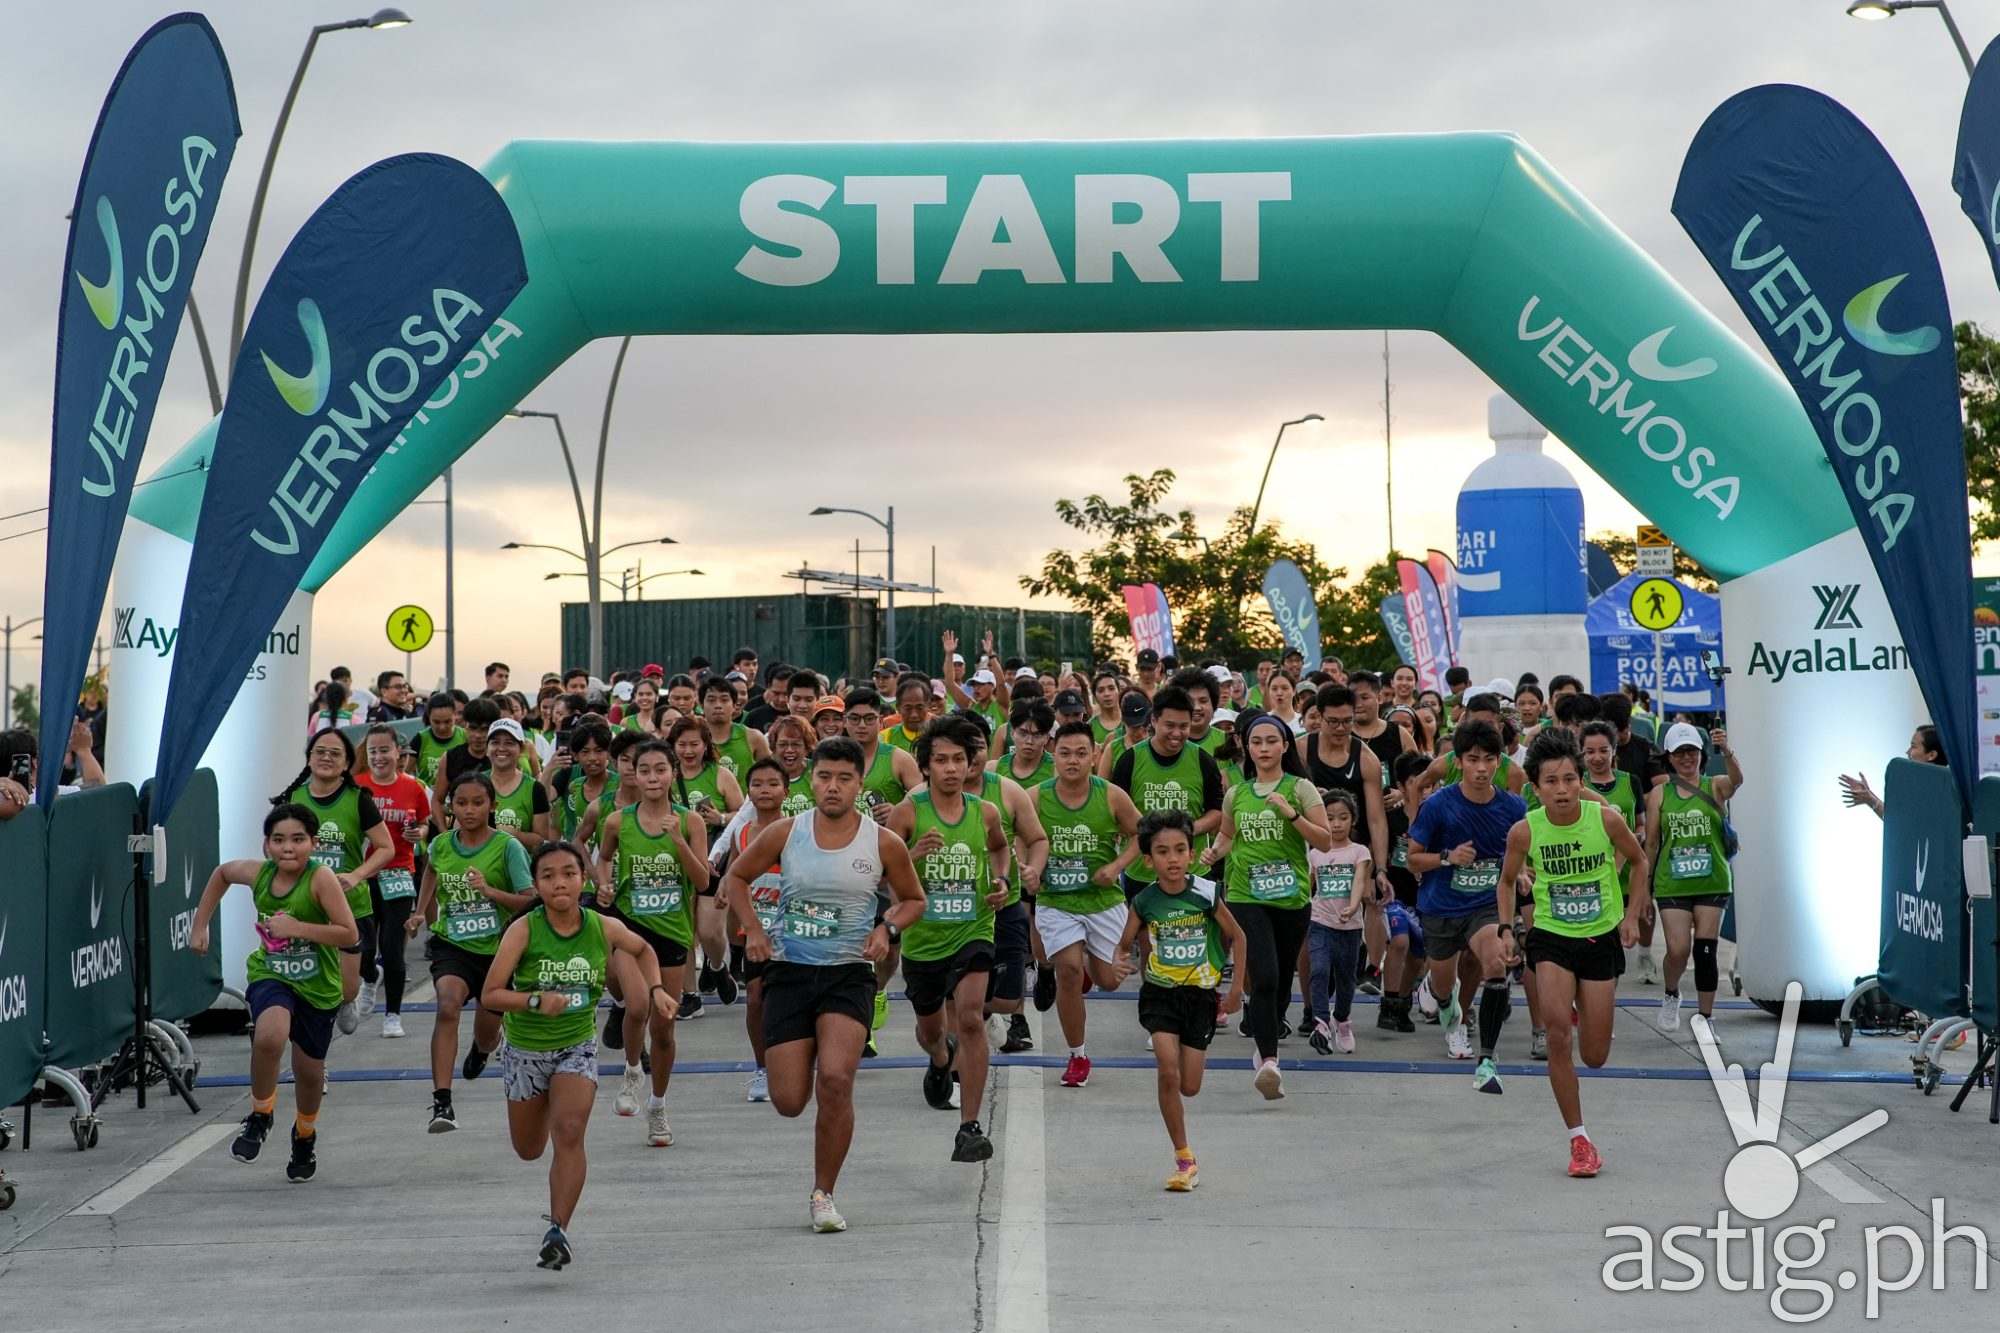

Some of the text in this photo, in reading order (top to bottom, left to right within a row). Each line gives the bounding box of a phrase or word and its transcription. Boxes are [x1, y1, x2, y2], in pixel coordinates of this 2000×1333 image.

[733, 171, 1292, 287] START
[82, 135, 217, 498] VERMOSA
[1731, 213, 1916, 552] VERMOSA
[1517, 295, 1740, 521] VERMOSA
[250, 288, 484, 555] VERMOSA
[1747, 637, 1908, 683] AyalaLan
[1241, 827, 1277, 842] Run
[1670, 823, 1706, 840] Run
[1053, 840, 1092, 853] Run
[1539, 843, 1571, 860] TAKBO
[924, 864, 971, 881] Run
[1279, 863, 1291, 871] 3K
[1677, 859, 1709, 873] 3107
[1050, 872, 1088, 885] 3070
[1256, 874, 1294, 891] 3040
[1458, 874, 1498, 886] 3054
[480, 902, 492, 910] 3K
[638, 892, 680, 908] 3076
[934, 898, 973, 913] 3159
[1556, 899, 1601, 915] 3084
[823, 911, 835, 919] 3K
[1896, 890, 1944, 943] VERMOSA
[456, 915, 496, 935] 3081
[794, 919, 832, 937] 3114
[1163, 943, 1206, 960] 3087
[71, 935, 122, 989] VERMOSA
[271, 958, 315, 974] 3100
[538, 959, 565, 971] The
